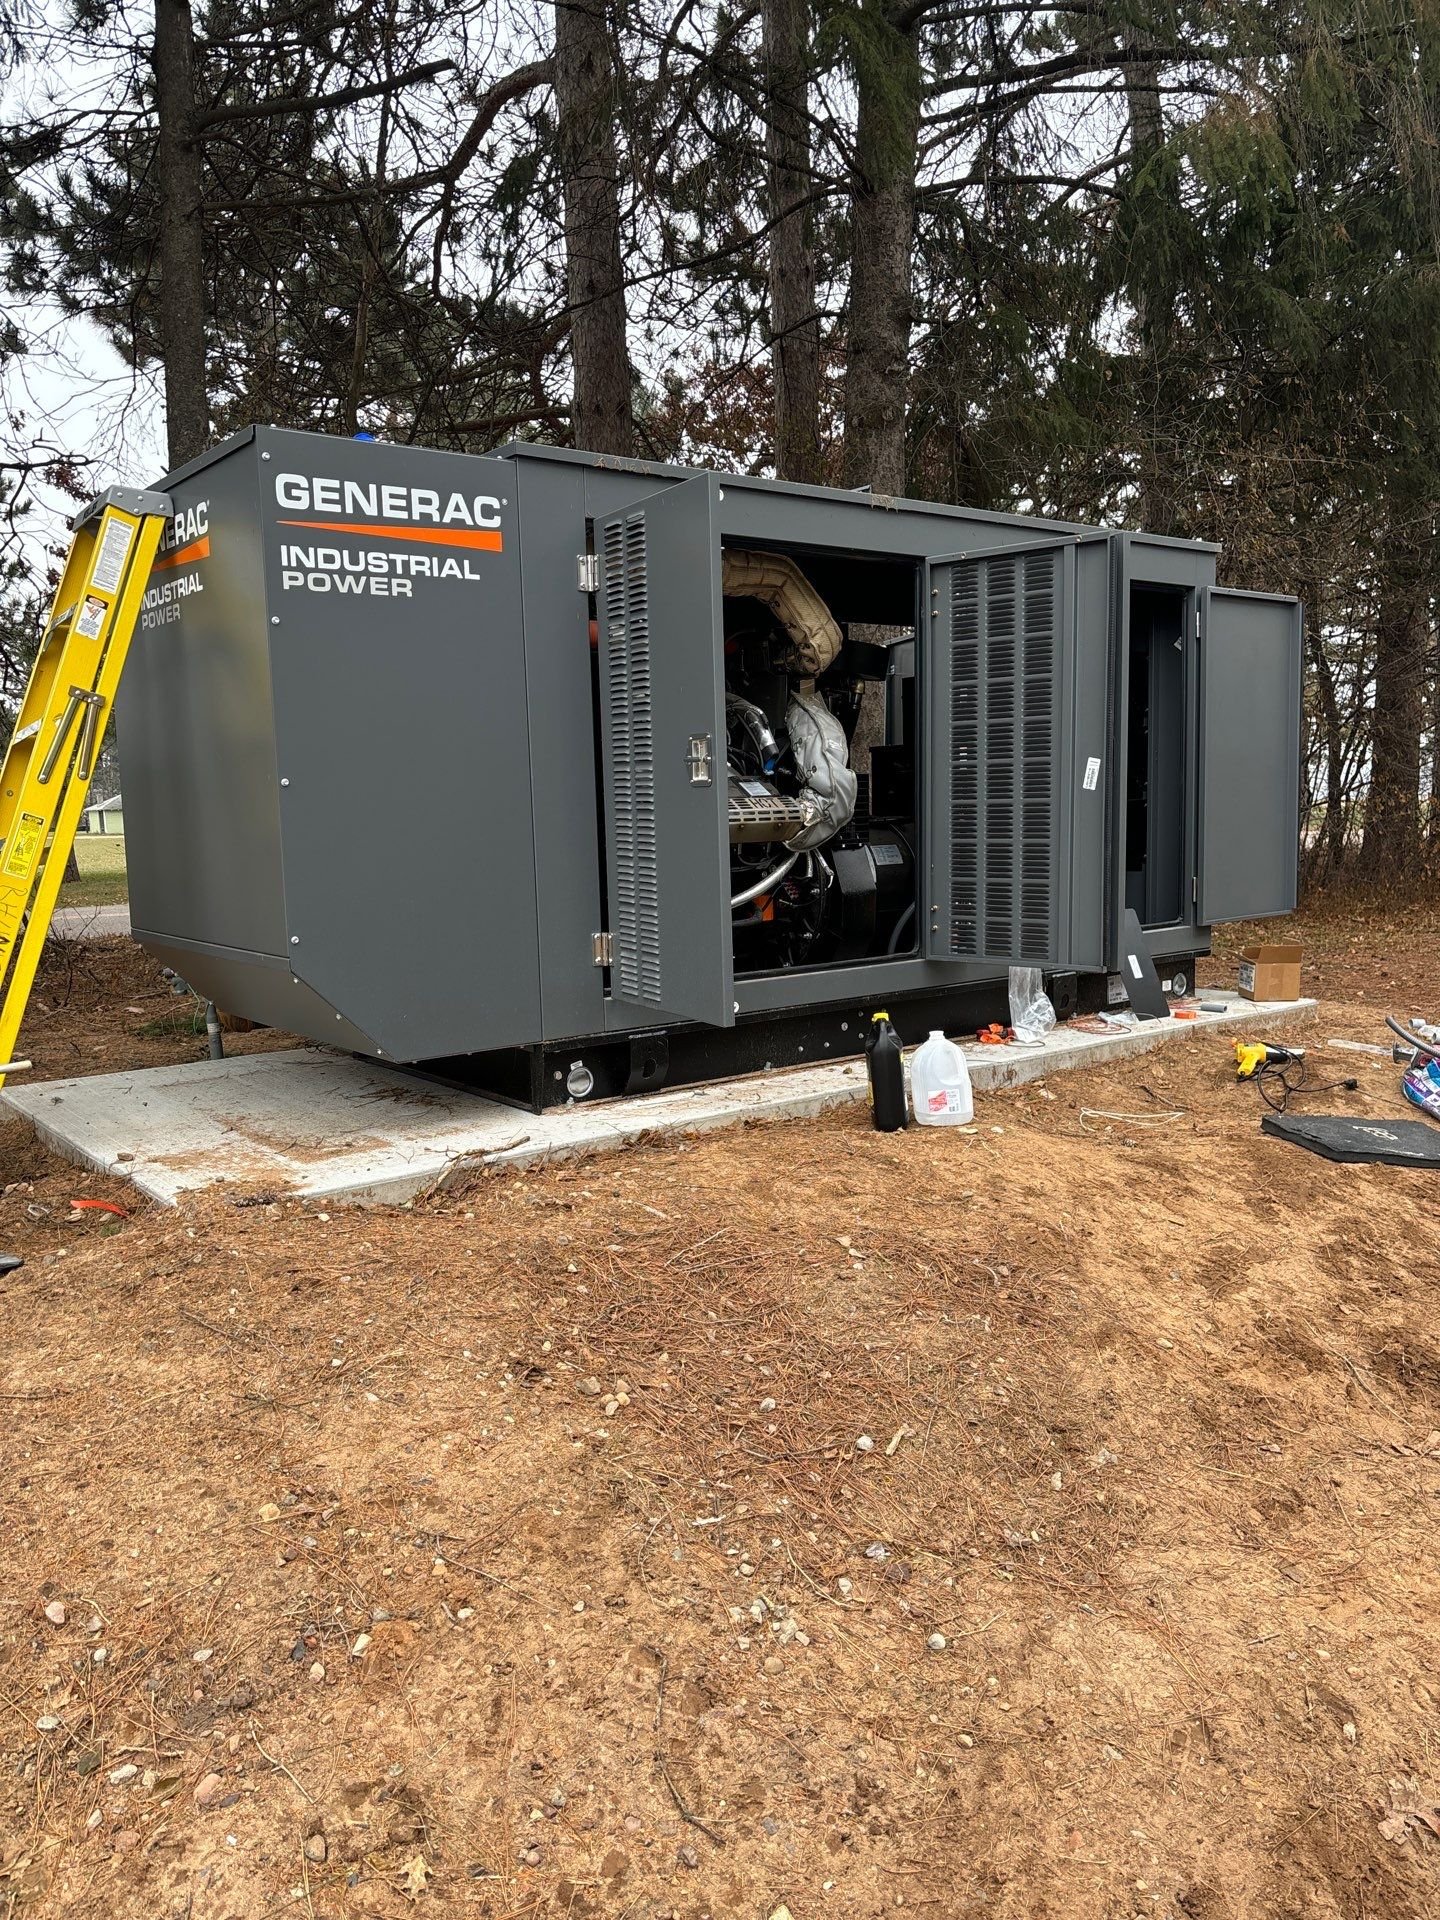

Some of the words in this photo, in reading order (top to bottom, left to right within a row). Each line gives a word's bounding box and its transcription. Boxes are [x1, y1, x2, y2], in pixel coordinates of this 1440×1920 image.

[275, 473, 502, 528] GENERAC
[280, 545, 480, 580] INDUSTRIAL
[282, 571, 413, 597] POWER
[141, 603, 181, 631] POWER
